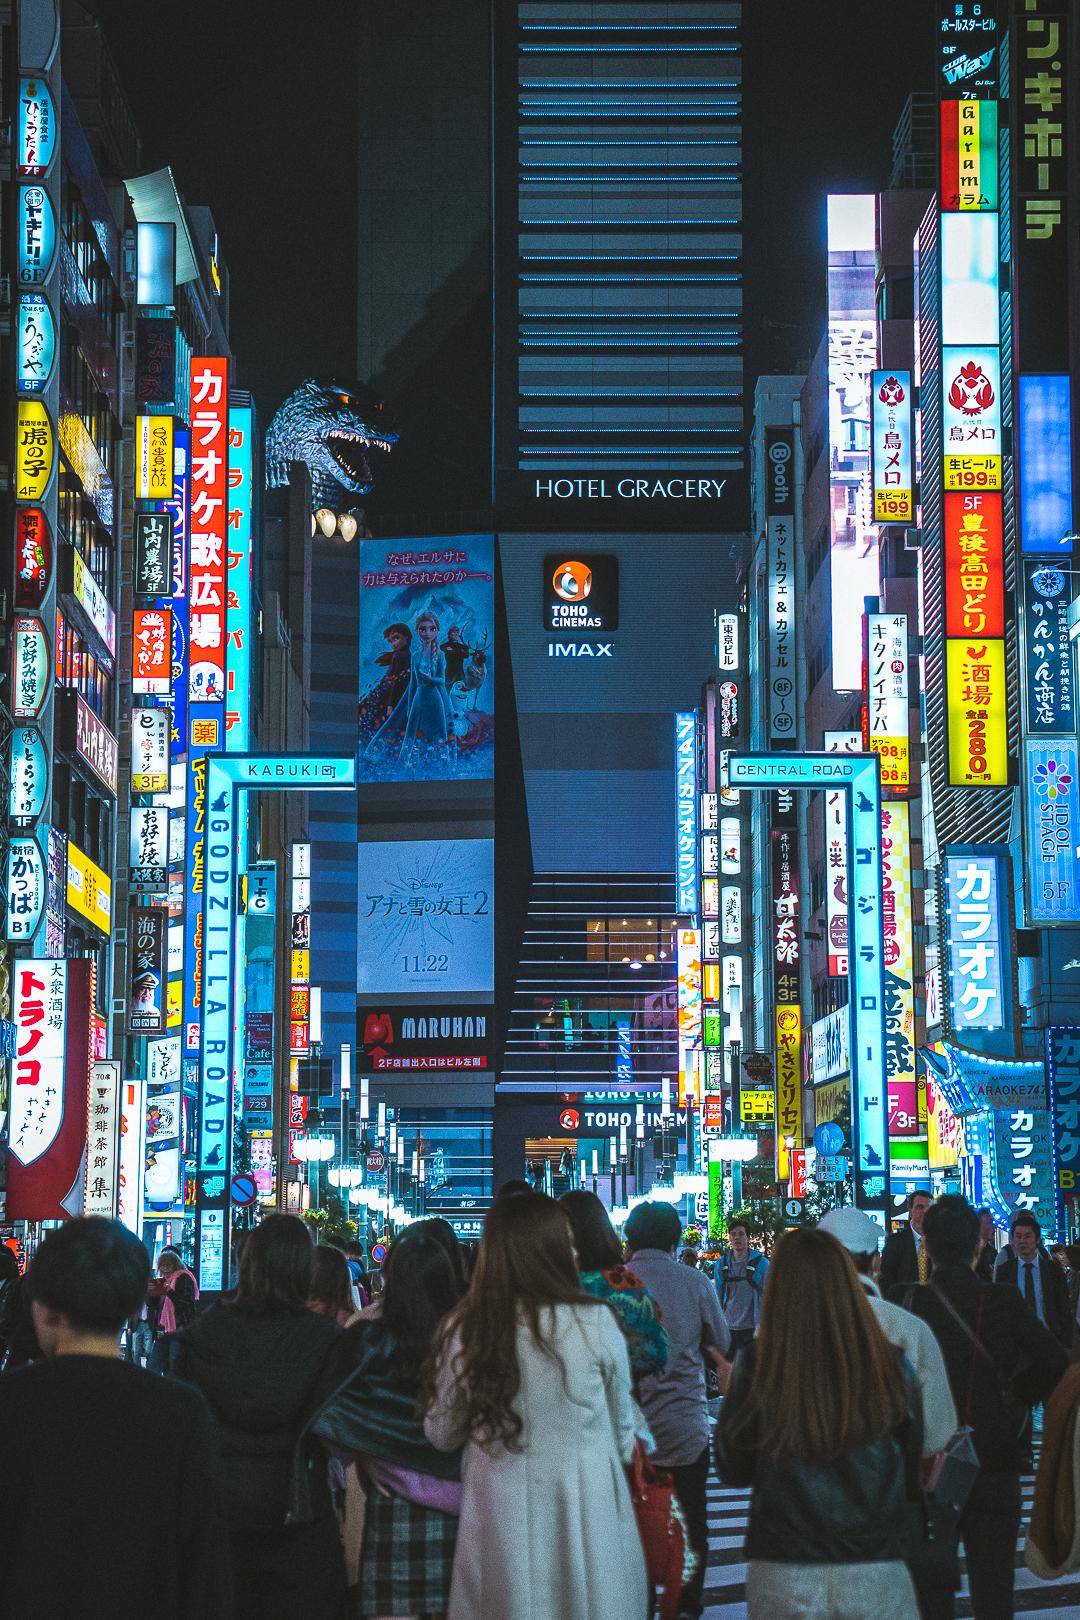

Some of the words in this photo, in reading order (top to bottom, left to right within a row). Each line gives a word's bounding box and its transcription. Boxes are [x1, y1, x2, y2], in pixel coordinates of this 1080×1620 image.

[973, 4, 981, 16] 6
[942, 54, 968, 72] CLUB
[962, 91, 977, 99] 7F
[21, 99, 39, 164] ひょうたん
[960, 105, 979, 187] Garam
[24, 166, 39, 175] 7F
[950, 193, 991, 206] ガラム
[25, 205, 42, 259] ヤキトリ
[21, 268, 45, 282] 6F
[24, 381, 39, 390] 5F
[948, 425, 996, 442] 鳥メロ
[20, 427, 48, 478] 虎の子
[882, 431, 902, 485] 鳥メロ
[949, 458, 996, 470] 生ビール
[956, 471, 988, 486] 199
[19, 486, 37, 497] 4F
[535, 478, 612, 499] HOTEL
[616, 478, 728, 499] GRACERY
[877, 492, 908, 500] 生ビール
[190, 367, 224, 649] カラオケ歌広場
[881, 500, 909, 514] 199
[963, 496, 982, 511] 5F
[141, 517, 164, 584] 山内農場
[387, 551, 467, 566] なぜ、エルサに
[958, 513, 989, 634] 豊後高田どり
[551, 605, 588, 616] TOHO
[551, 617, 602, 627] CINEMAS
[892, 618, 906, 627] 4F
[548, 642, 614, 657] IMAX
[723, 624, 734, 665] 東京ビル
[21, 634, 38, 707] お好み焼き
[1032, 600, 1056, 724] かんかん商店
[872, 624, 888, 732] キタノイチバ
[961, 663, 993, 706] 酒場
[194, 722, 216, 743] 薬
[677, 720, 695, 775] 747
[968, 719, 988, 774] 280
[736, 765, 810, 776] CENTRAL
[812, 765, 853, 776] ROAD
[141, 775, 160, 789] 3F
[15, 816, 32, 827] 1F
[1056, 803, 1070, 854] IDOL
[1040, 803, 1056, 863] STAGE
[677, 782, 696, 908] カラオケランド
[10, 856, 34, 914] かっぱ
[407, 877, 444, 892] Disney
[1042, 881, 1070, 900] 5F
[12, 921, 31, 933] B1
[207, 819, 231, 1016] GODZILLA
[137, 916, 157, 969] 海の家
[955, 862, 998, 1021] カラオケ
[401, 954, 450, 973] 11.22
[777, 974, 798, 987] 4F
[855, 846, 879, 1112] ゴジラロード
[47, 962, 65, 1031] 大衆酒場
[777, 988, 798, 1001] 3F
[16, 970, 46, 1087] トラノコ
[401, 1016, 487, 1039] MARUHAN
[246, 1048, 271, 1059] Cafe
[204, 1039, 227, 1134] ROAD
[35, 1085, 58, 1135] やきとり
[249, 1101, 267, 1109] 729
[742, 1100, 775, 1113] ロード
[584, 1112, 632, 1127] TOHO
[891, 1164, 928, 1174] FamilyMart
[1009, 1110, 1040, 1210] カラオケ
[89, 1176, 111, 1199] 集
